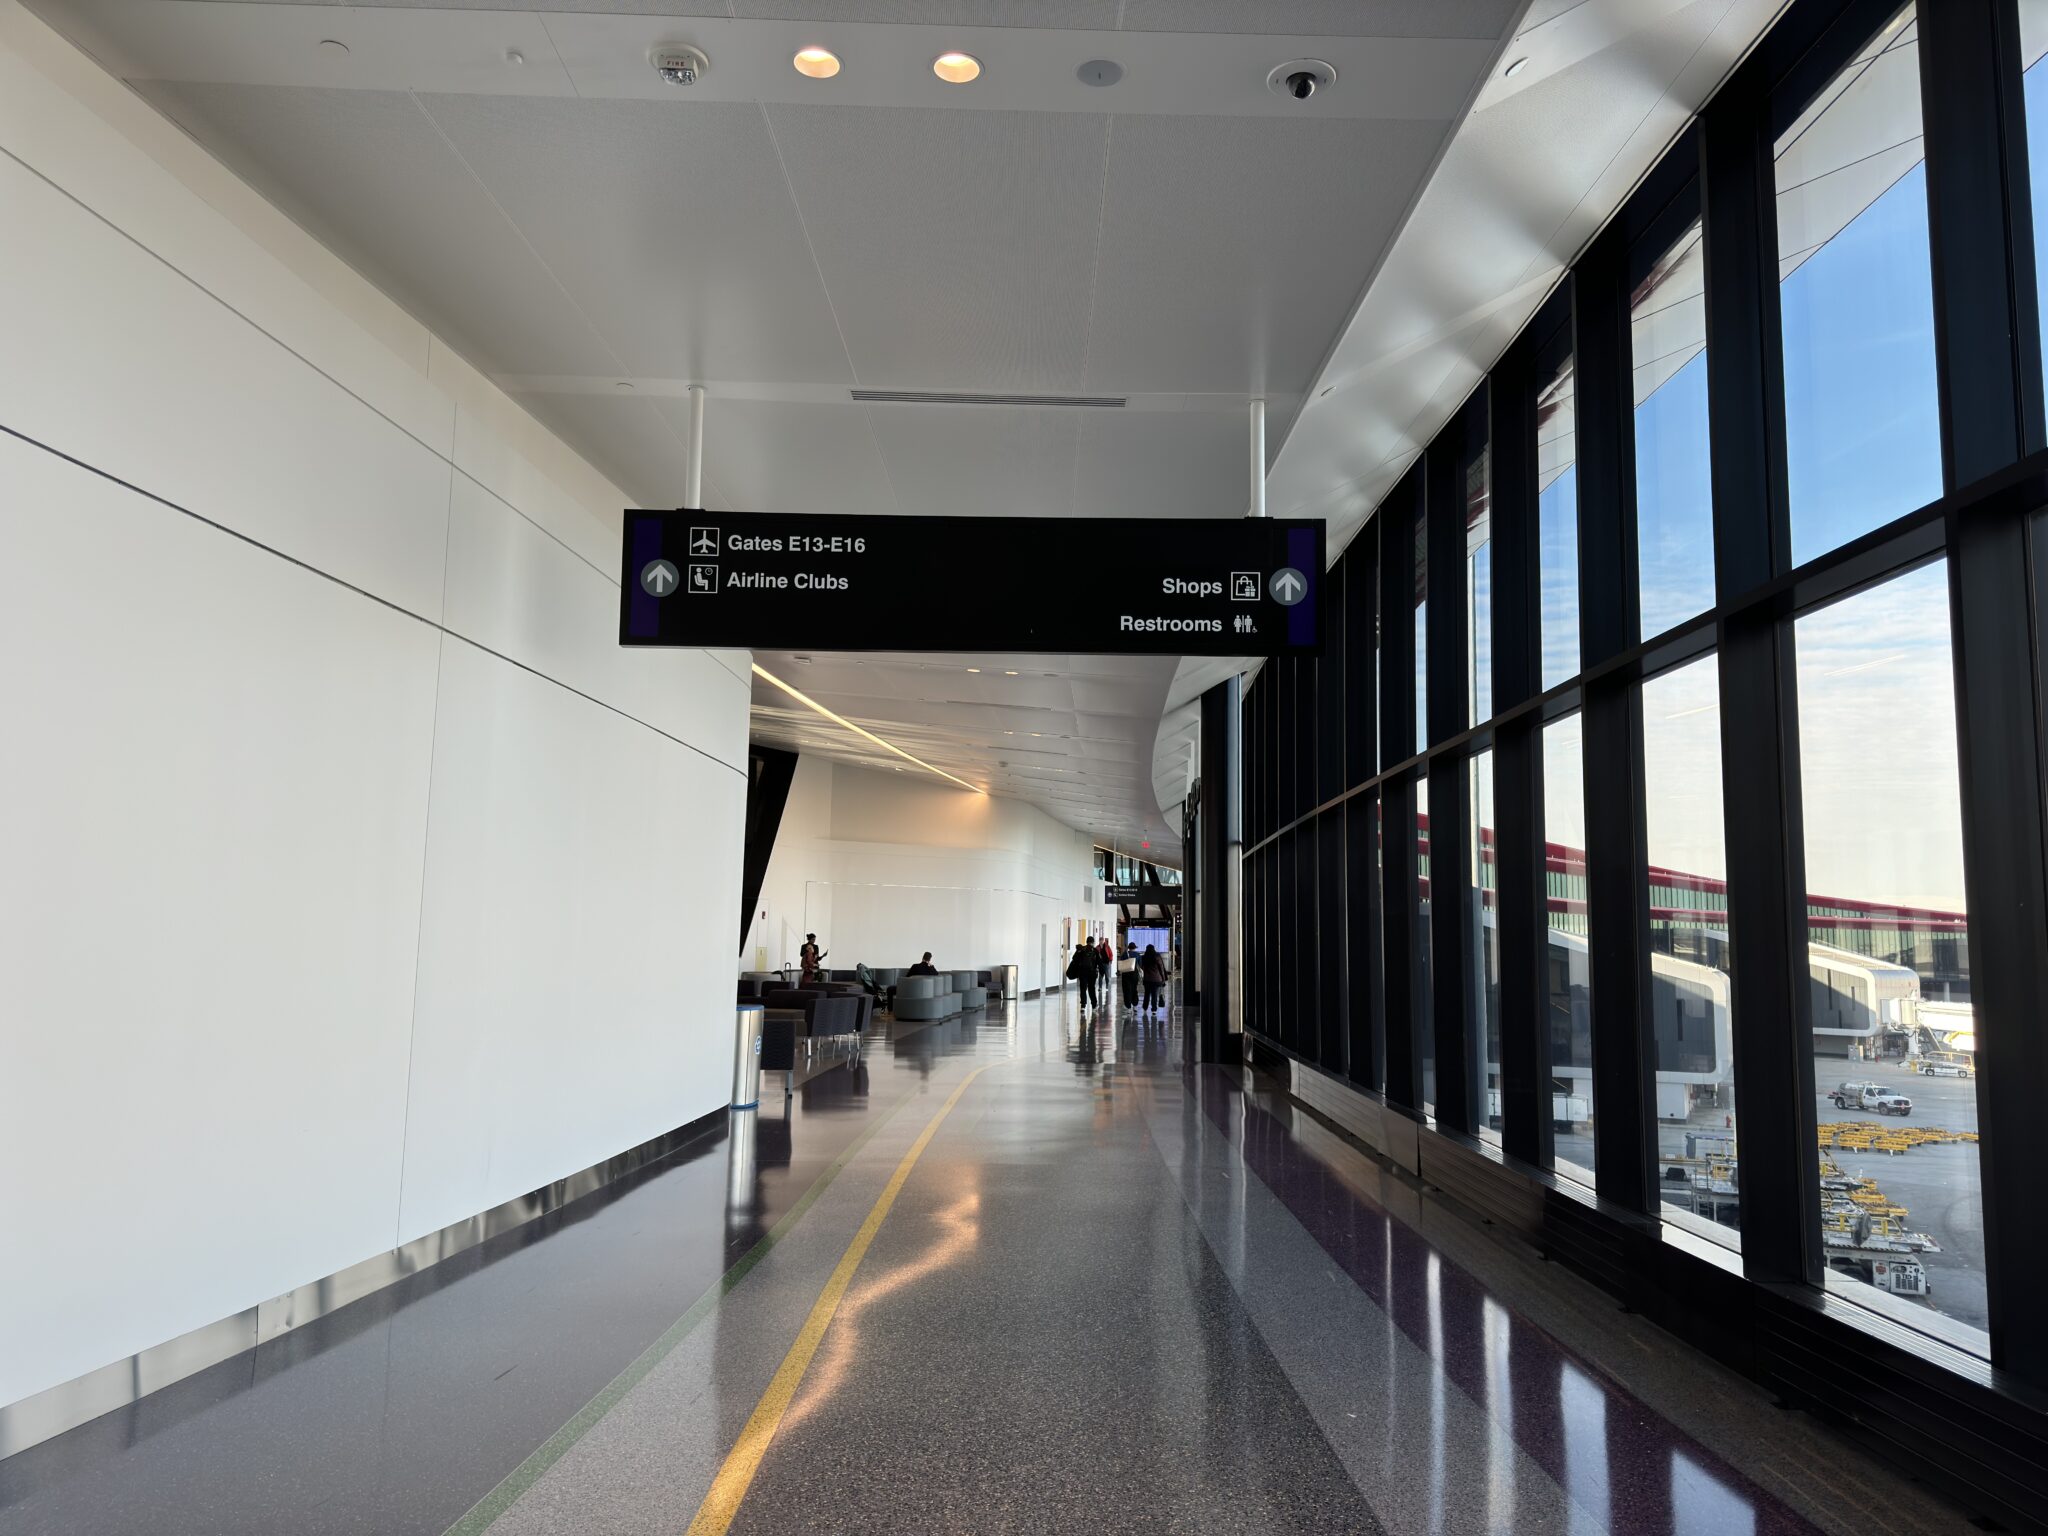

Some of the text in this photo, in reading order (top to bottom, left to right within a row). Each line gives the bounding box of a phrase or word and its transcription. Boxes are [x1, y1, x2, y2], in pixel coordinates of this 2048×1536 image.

[727, 535, 866, 553] Gates E13-E16
[726, 572, 849, 590] Airline Clubs
[1162, 578, 1223, 598] Shops
[1120, 616, 1223, 632] Restrooms
